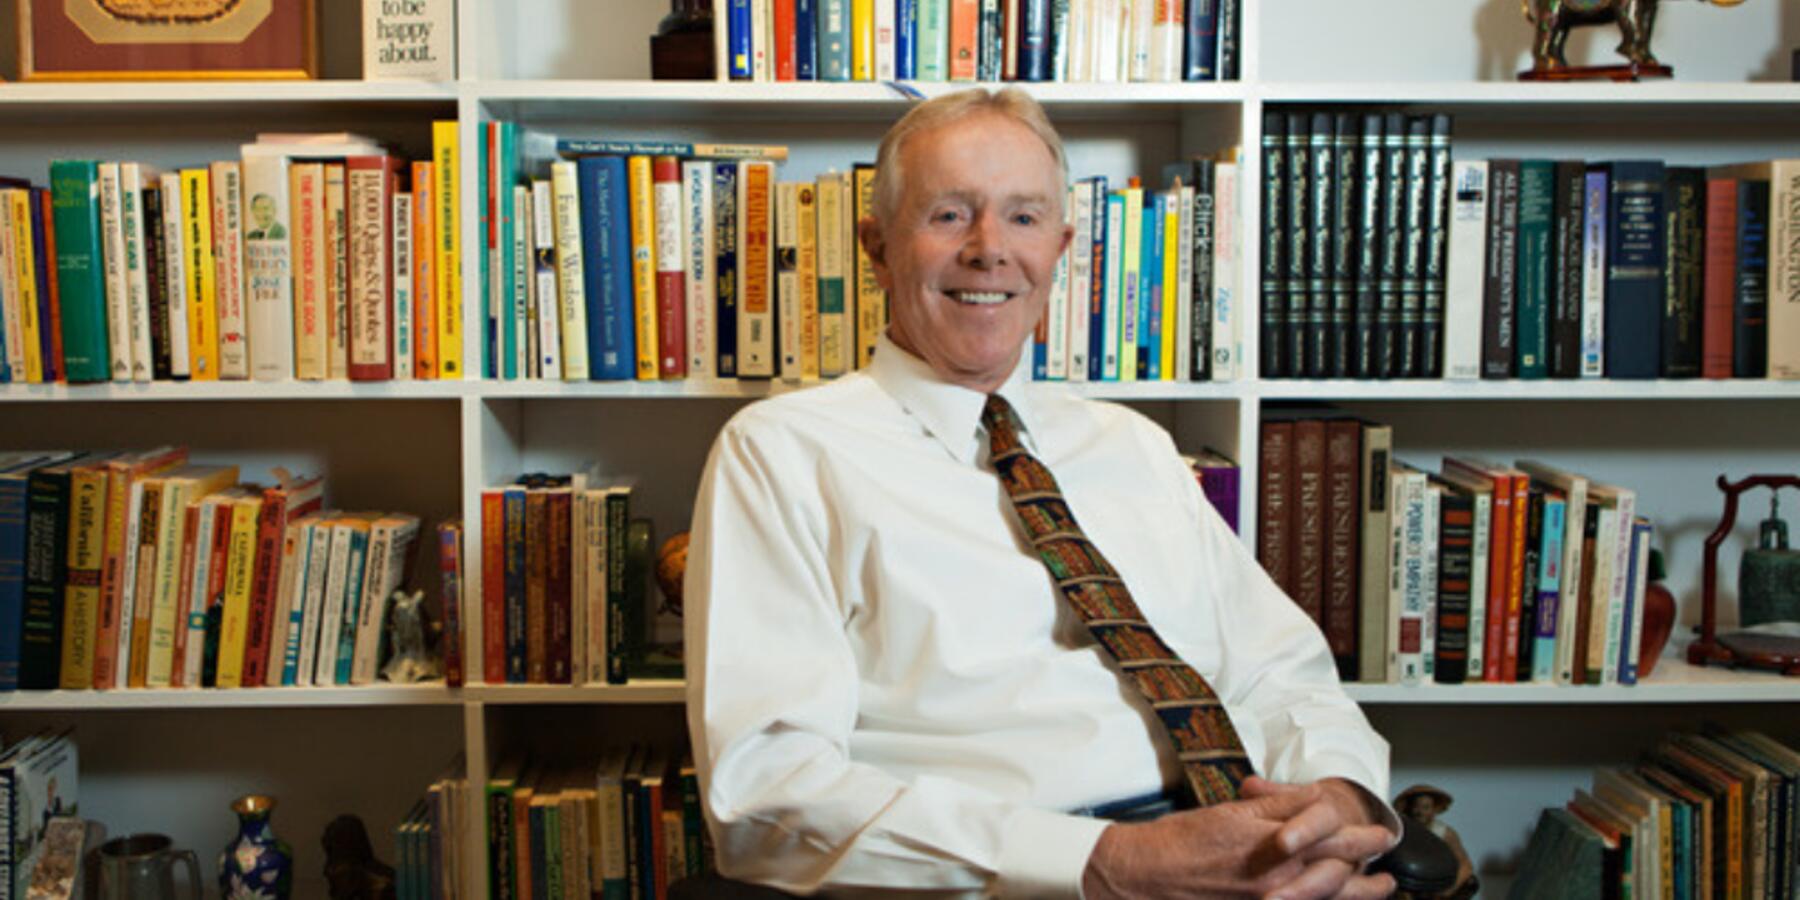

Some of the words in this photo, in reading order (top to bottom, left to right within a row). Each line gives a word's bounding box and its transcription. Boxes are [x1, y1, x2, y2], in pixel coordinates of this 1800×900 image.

[382, 0, 401, 16] to
[402, 0, 426, 16] be
[376, 18, 435, 43] happy
[379, 42, 437, 63] about.
[302, 175, 312, 194] THE
[1504, 173, 1516, 197] ALL
[560, 193, 576, 250] Family
[1195, 194, 1213, 250] Click
[1503, 202, 1515, 226] THE
[362, 223, 381, 268] Quips
[1788, 176, 1800, 302] WASHINGTON
[366, 270, 381, 287] &
[563, 256, 578, 323] Wisdom
[305, 305, 316, 335] BOOK
[364, 289, 381, 344] Quotes
[1499, 316, 1511, 348] MEN
[1409, 481, 1422, 499] THE
[78, 483, 97, 567] California
[1332, 472, 1350, 605] PRESIDENTS
[1407, 502, 1423, 544] POWER
[1405, 559, 1424, 612] EMPATHY
[72, 602, 88, 668] HISTORY
